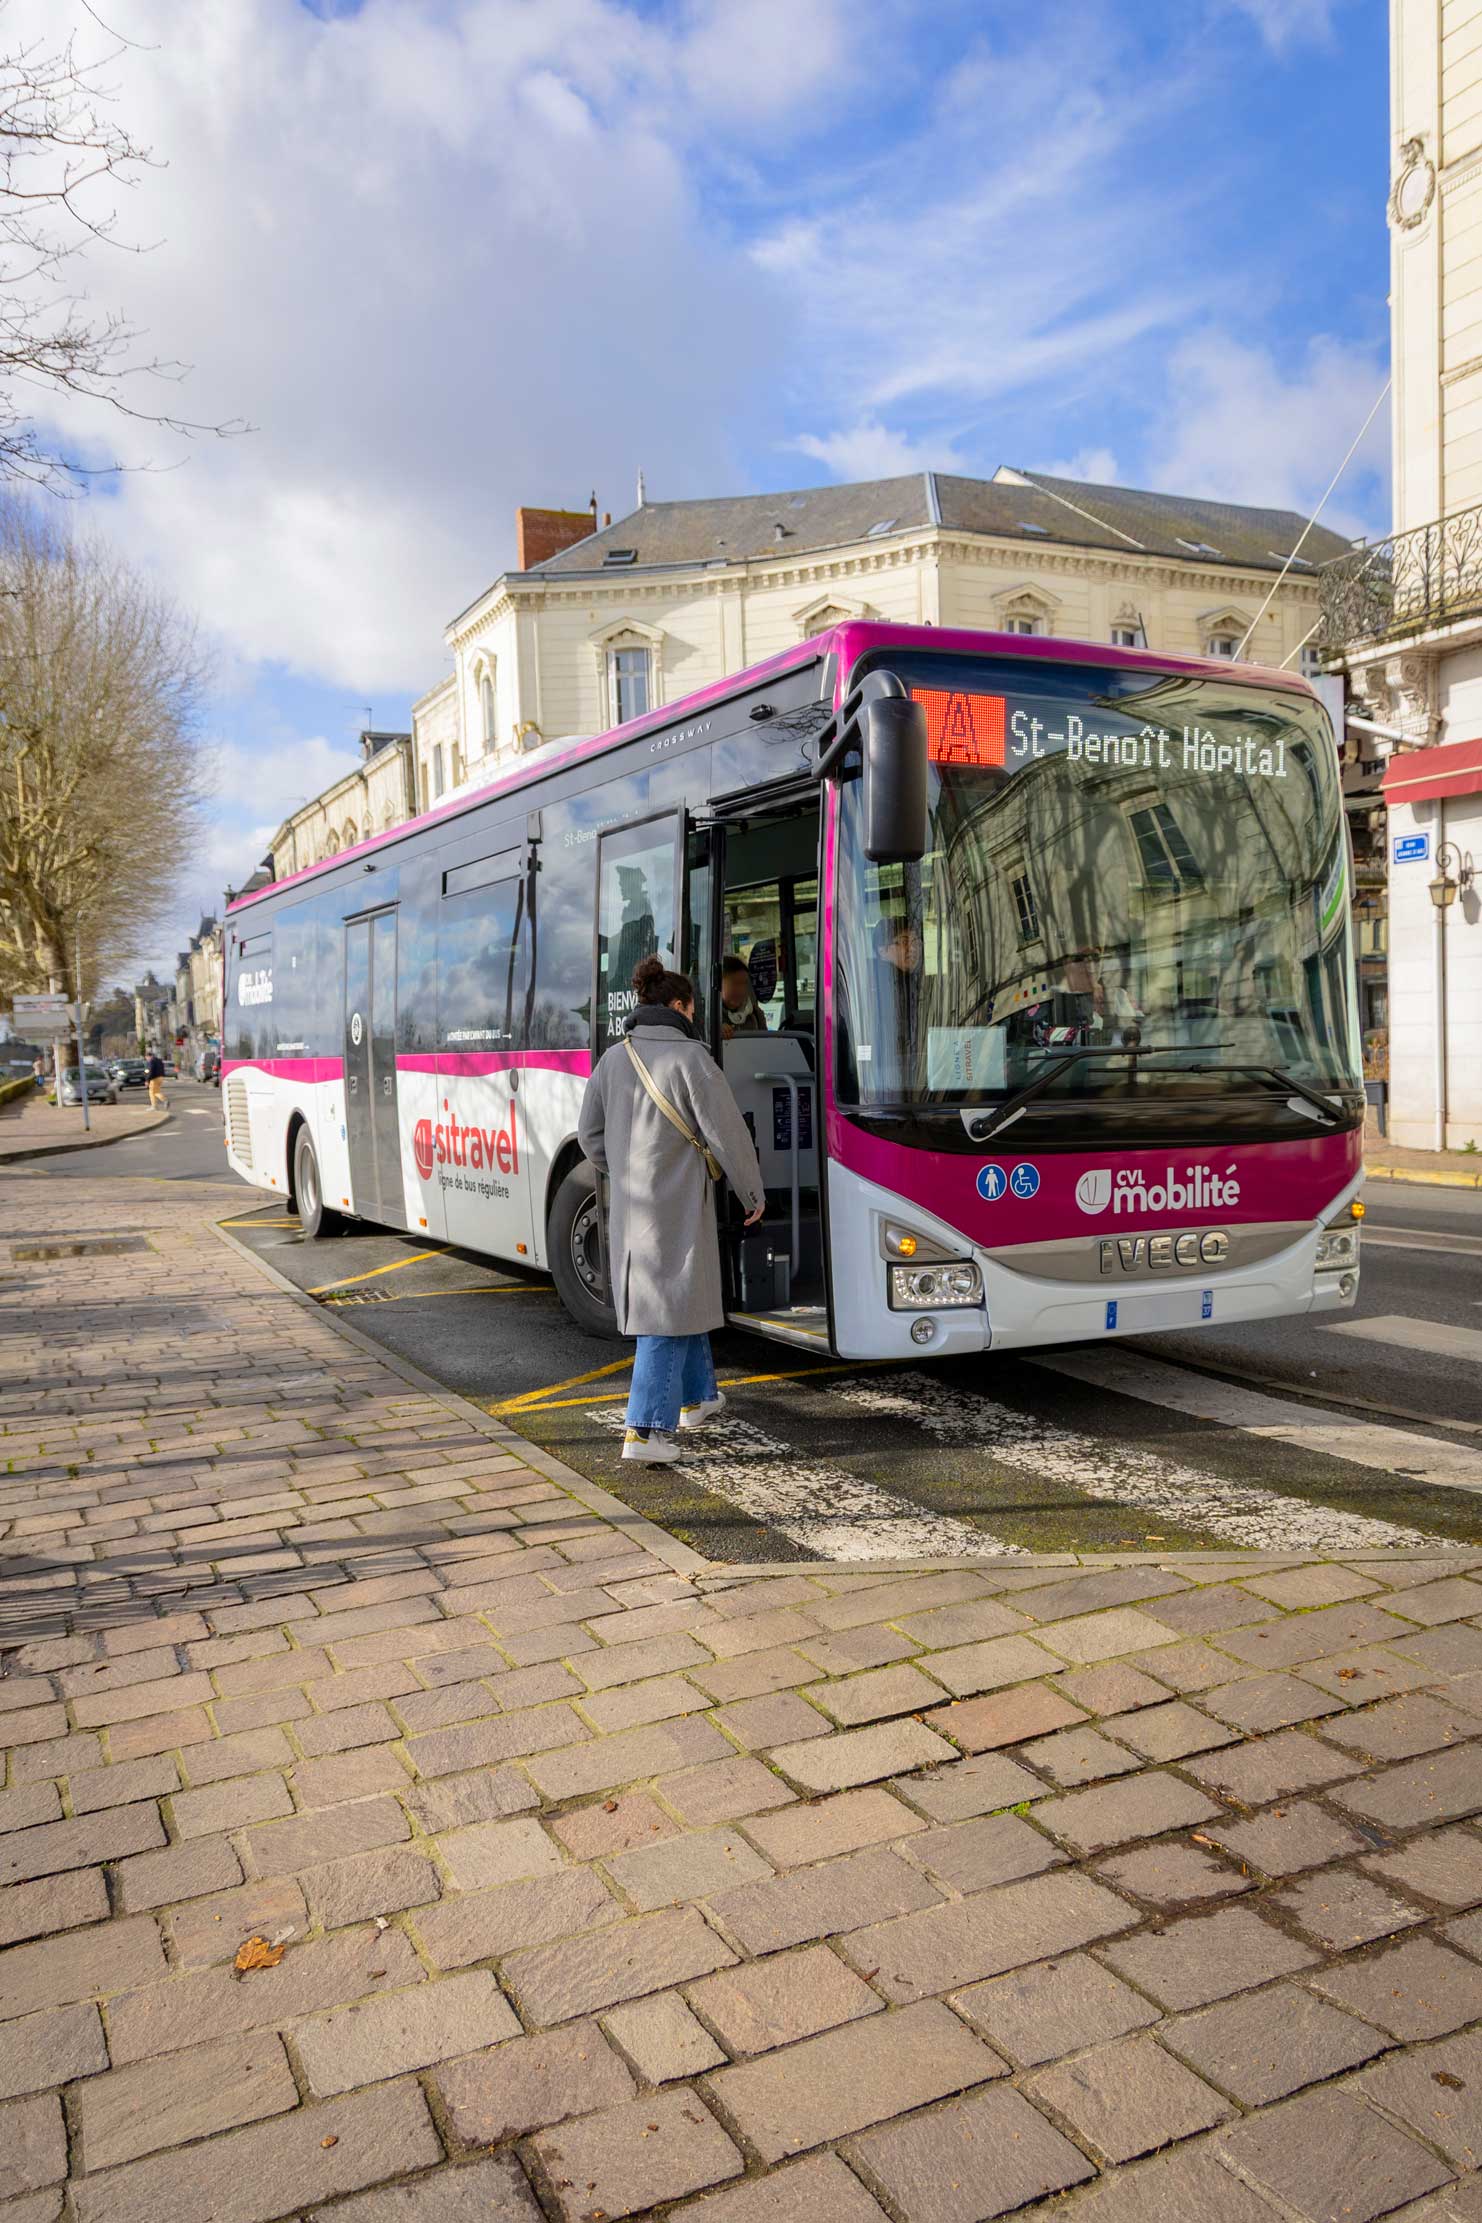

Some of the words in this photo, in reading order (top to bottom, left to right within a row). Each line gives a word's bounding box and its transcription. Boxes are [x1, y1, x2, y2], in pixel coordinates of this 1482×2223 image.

[650, 720, 711, 752] CROSSWAY
[938, 690, 980, 763] A
[1010, 710, 1172, 768] St-Benoît
[1183, 726, 1288, 777] Hôpital
[564, 826, 600, 848] St-Beno
[608, 991, 638, 1011] BIENV
[607, 1012, 615, 1036] À
[964, 1040, 973, 1081] SITRAVEL
[435, 1098, 519, 1175] sitravel
[438, 1170, 453, 1191] ligne
[454, 1173, 463, 1190] de
[464, 1175, 476, 1192] bus
[477, 1177, 509, 1199] régulière
[1113, 1163, 1241, 1214] mobilité
[1116, 1169, 1145, 1186] CVL
[1099, 1230, 1230, 1274] IVECO
